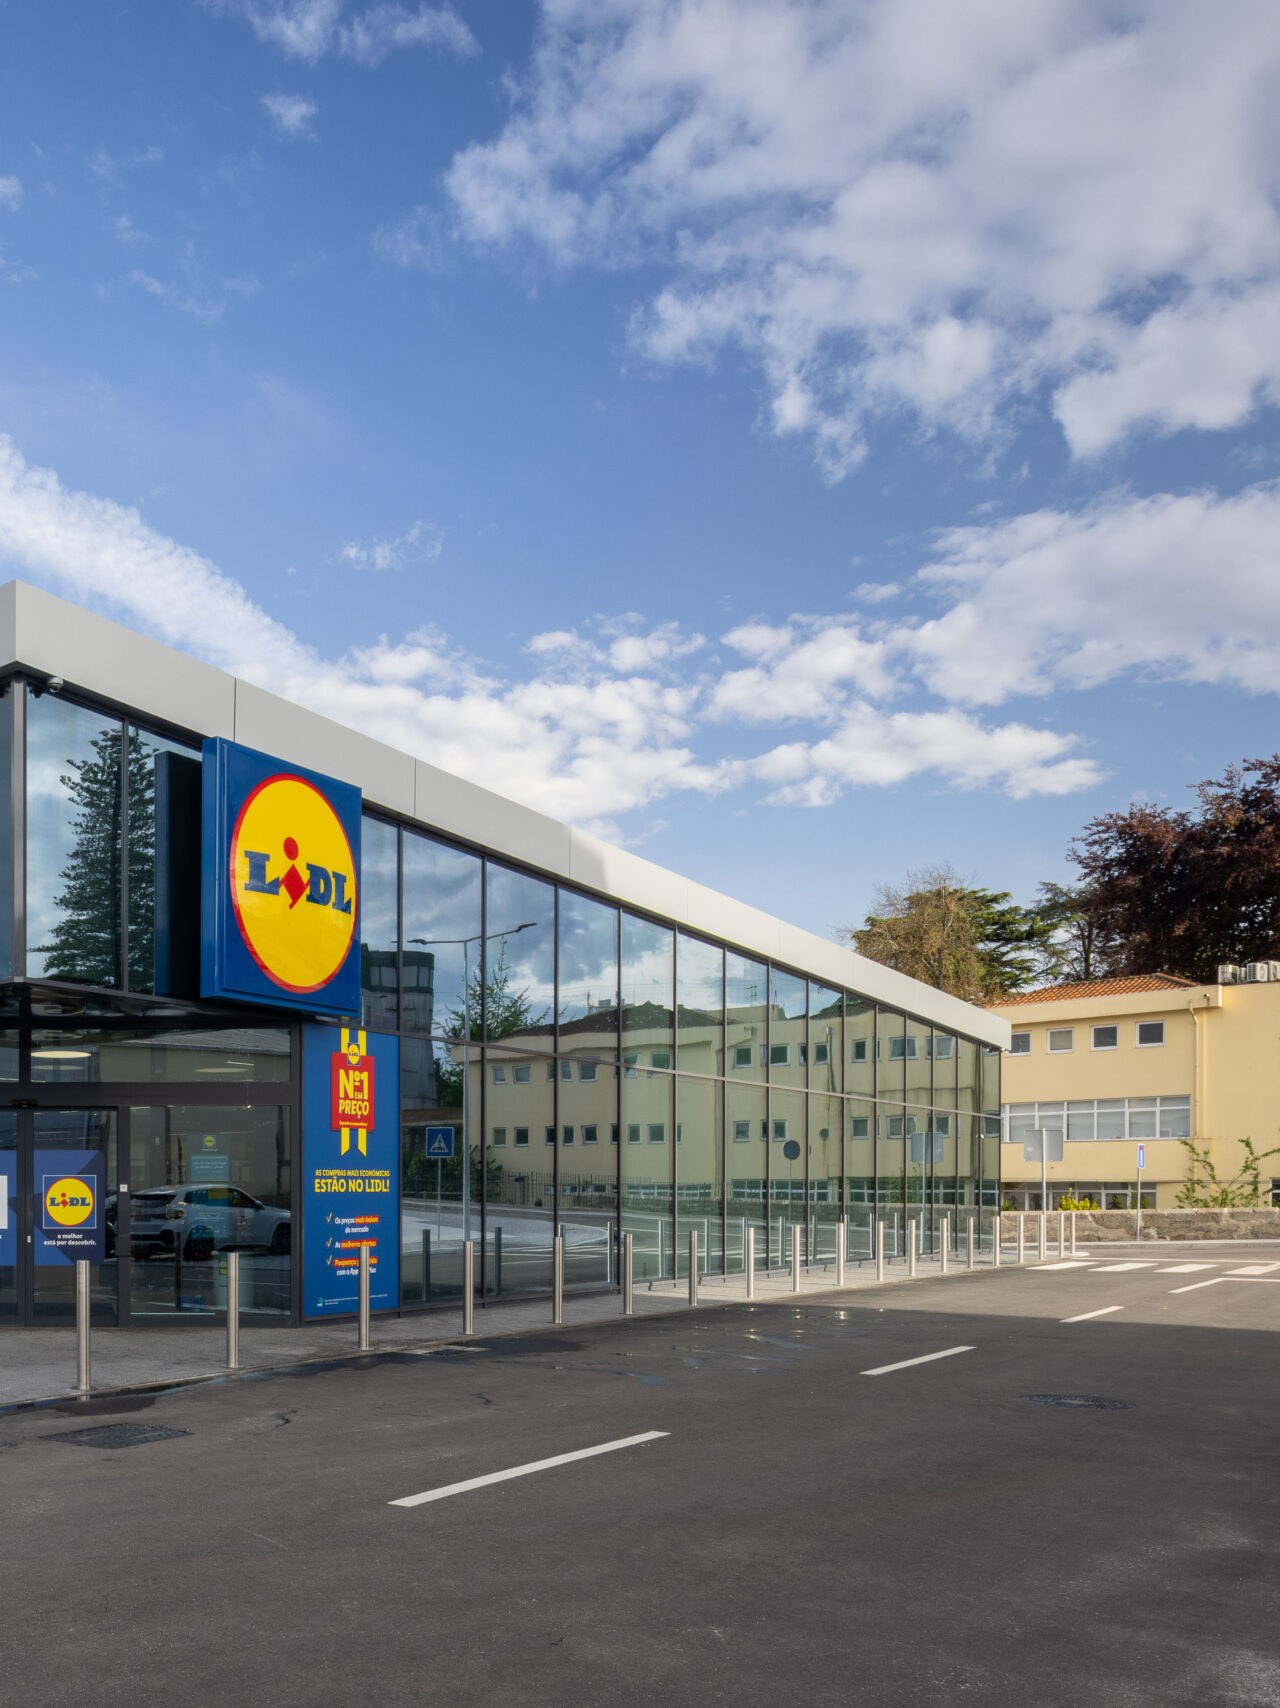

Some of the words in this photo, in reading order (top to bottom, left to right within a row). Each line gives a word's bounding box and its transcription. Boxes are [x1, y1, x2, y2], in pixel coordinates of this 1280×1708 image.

[339, 1099, 369, 1118] PREÇO
[315, 1169, 322, 1177] AS
[322, 1169, 346, 1177] COMPRAS
[347, 1169, 359, 1177] MAIS
[360, 1168, 390, 1177] ECONÓMICAS
[315, 1176, 347, 1193] ESTÃO
[348, 1179, 363, 1193] NO
[366, 1179, 390, 1193] LIDL!
